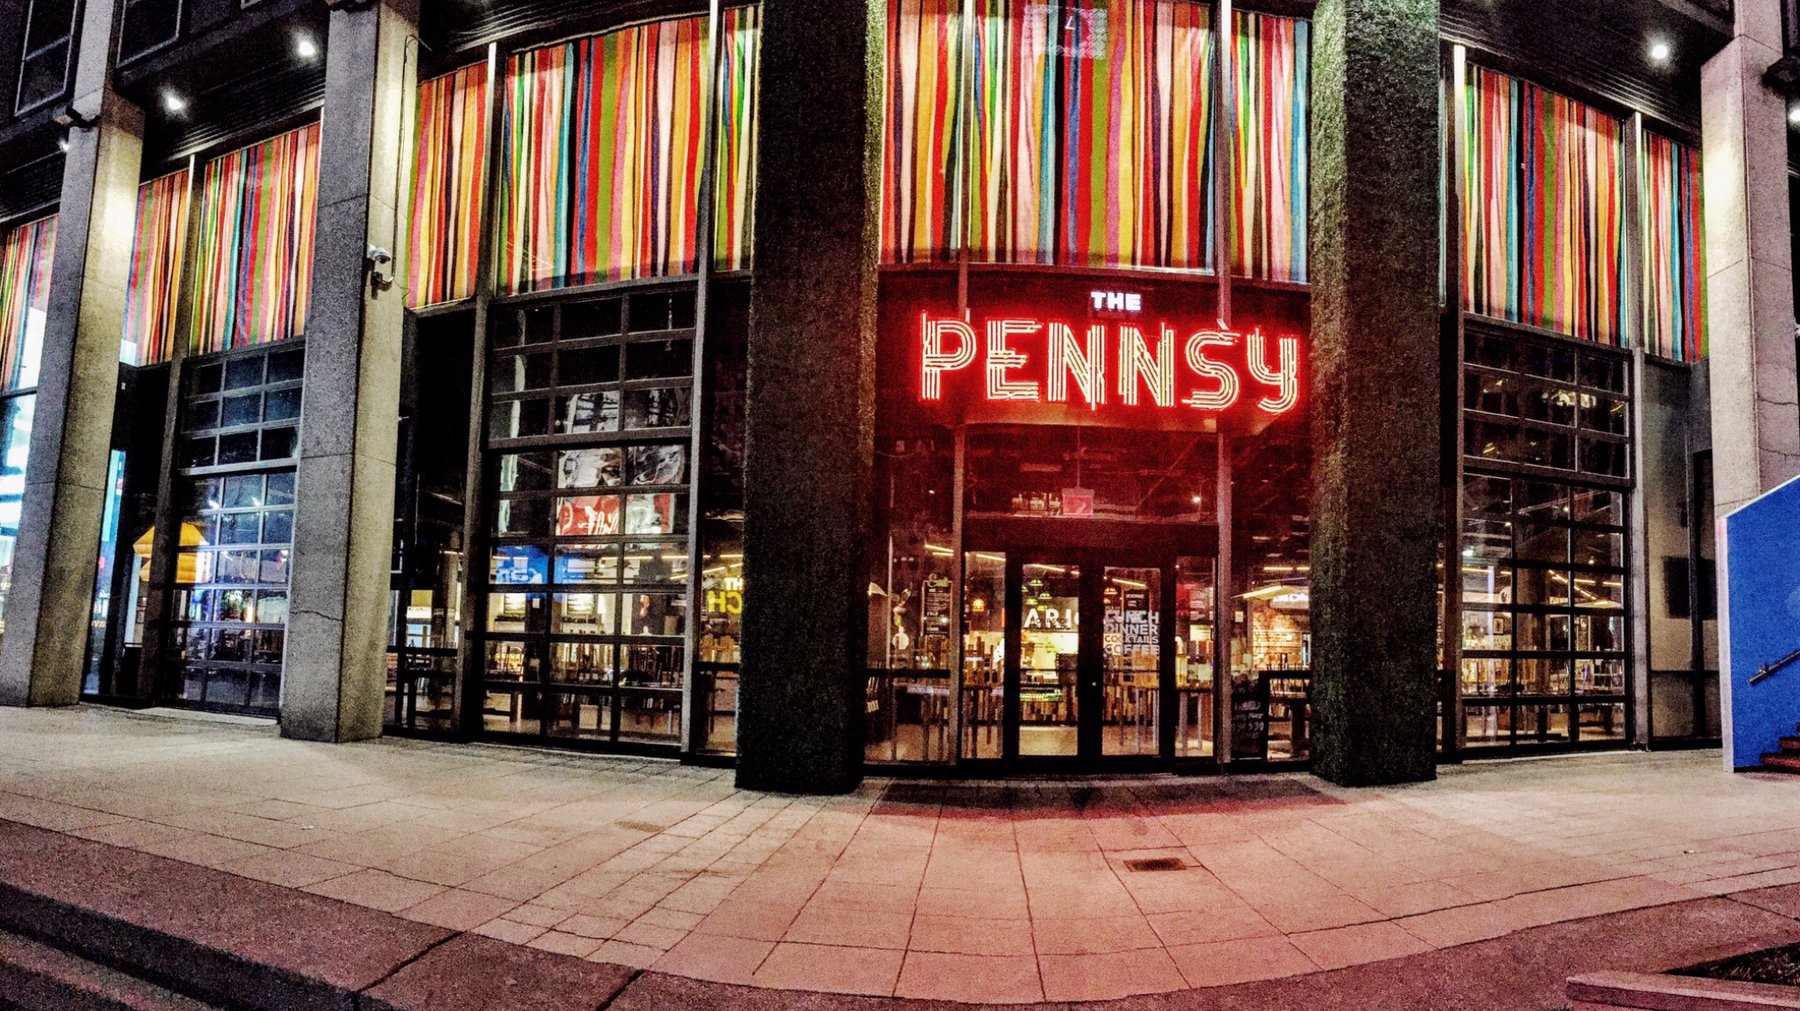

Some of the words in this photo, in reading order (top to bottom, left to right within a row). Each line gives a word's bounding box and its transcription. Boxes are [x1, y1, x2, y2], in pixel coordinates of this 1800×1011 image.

[1091, 291, 1142, 311] THE
[920, 310, 1299, 414] PENNSY
[1104, 624, 1159, 635] DINNER
